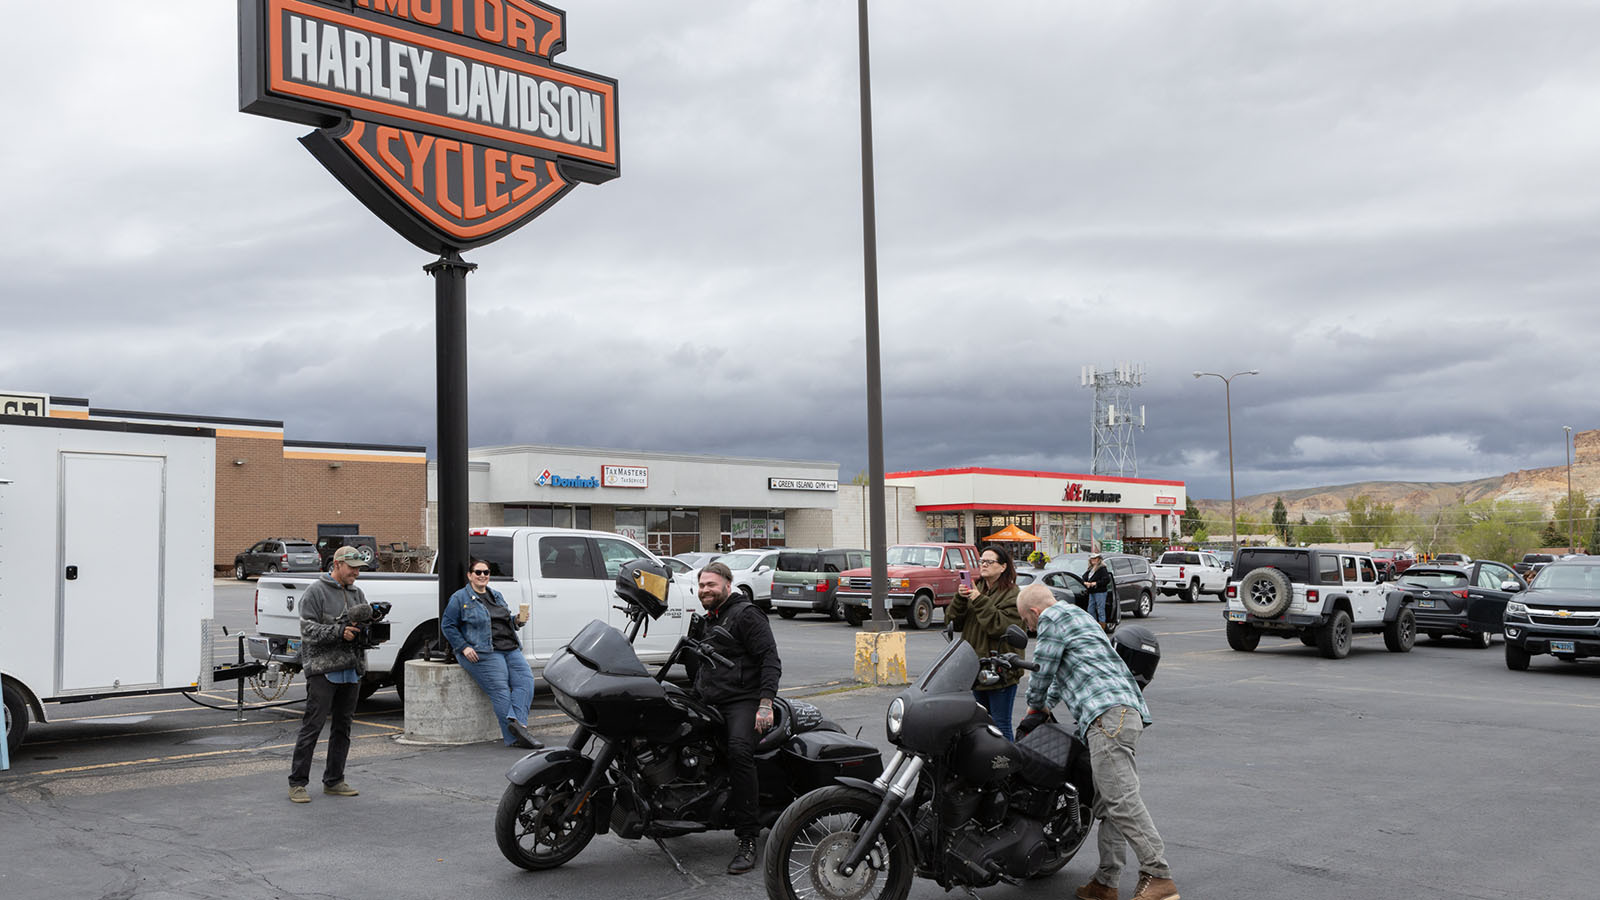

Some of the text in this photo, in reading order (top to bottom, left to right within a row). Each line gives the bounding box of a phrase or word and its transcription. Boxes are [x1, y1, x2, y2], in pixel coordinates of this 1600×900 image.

[290, 15, 602, 147] HARLEY-DAVIDSON
[376, 125, 537, 220] CYCLES
[551, 474, 600, 488] Domino's
[778, 480, 826, 489] GREEN ISLAND GYM
[1062, 480, 1121, 503] ACE Hardware
